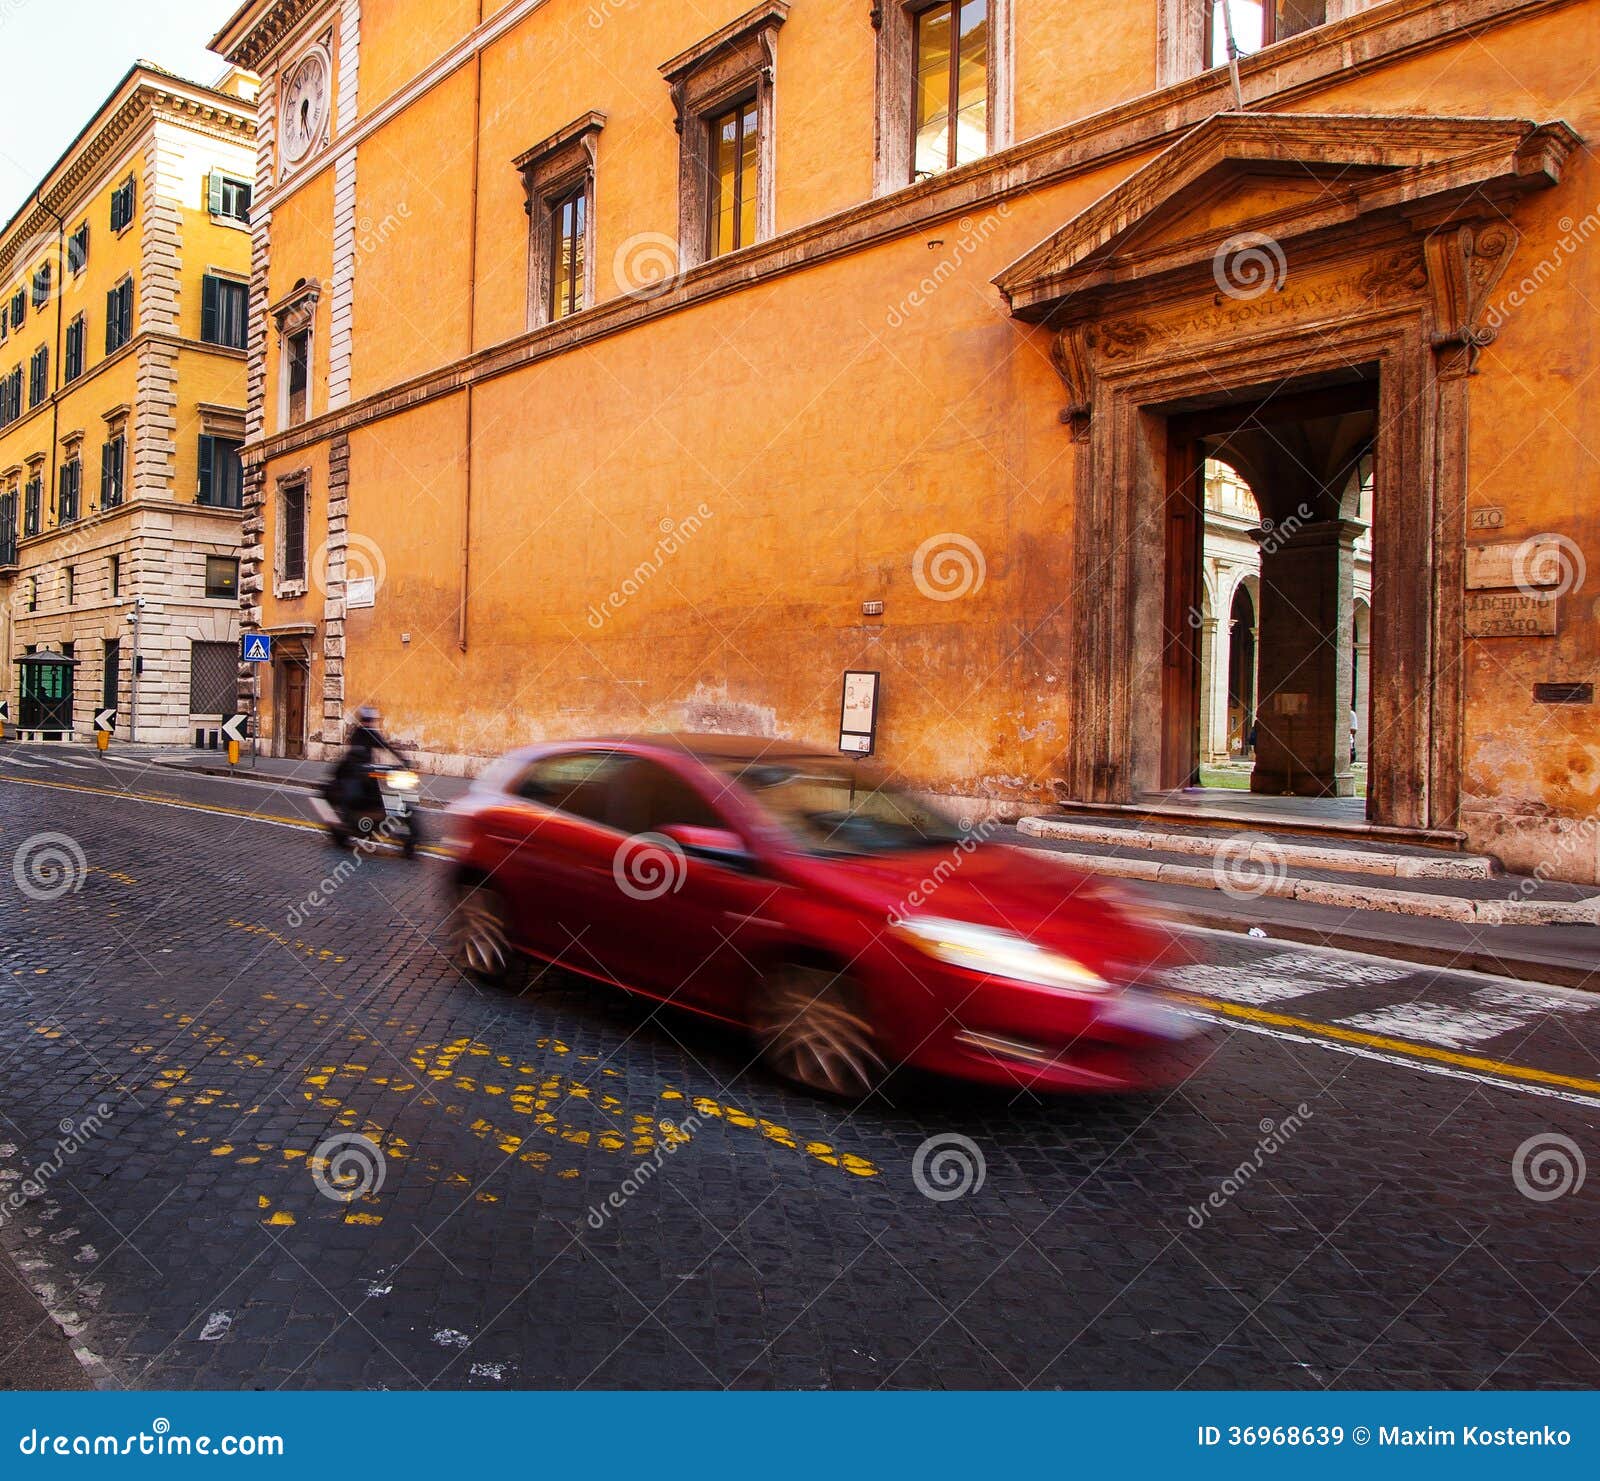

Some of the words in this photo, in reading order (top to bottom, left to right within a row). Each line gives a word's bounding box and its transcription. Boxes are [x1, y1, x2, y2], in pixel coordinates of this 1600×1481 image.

[1473, 510, 1502, 526] 40
[1469, 596, 1549, 611] ARCHIVIO
[1480, 619, 1538, 633] STATO
